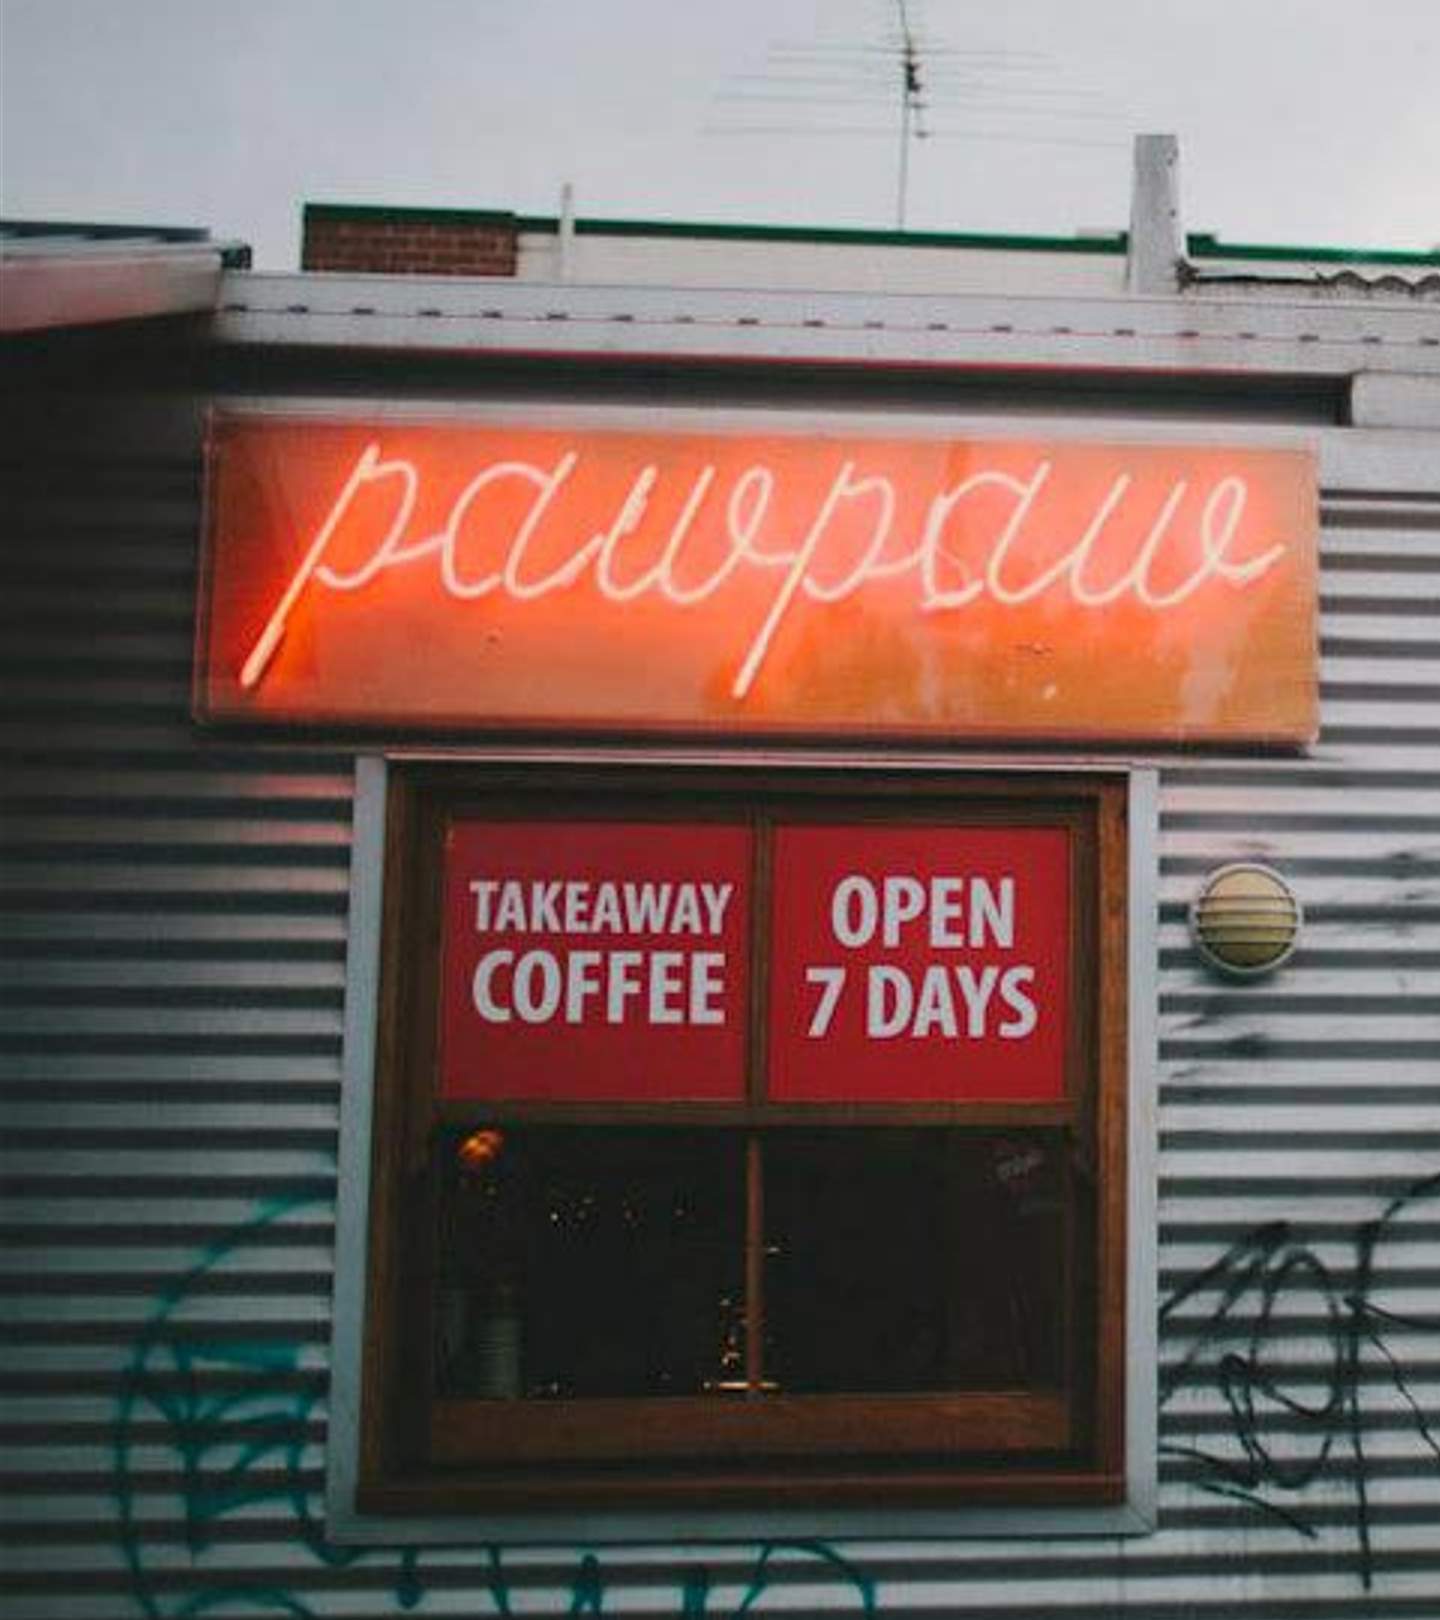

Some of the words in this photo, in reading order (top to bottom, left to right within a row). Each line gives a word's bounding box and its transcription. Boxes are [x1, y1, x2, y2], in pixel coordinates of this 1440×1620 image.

[240, 443, 1286, 700] pawpaw
[470, 882, 732, 934] TAKEAWAY
[832, 876, 1015, 948] OPEN
[473, 950, 725, 1025] COFFEE
[807, 967, 846, 1037] 7
[867, 965, 1038, 1038] DAYS
